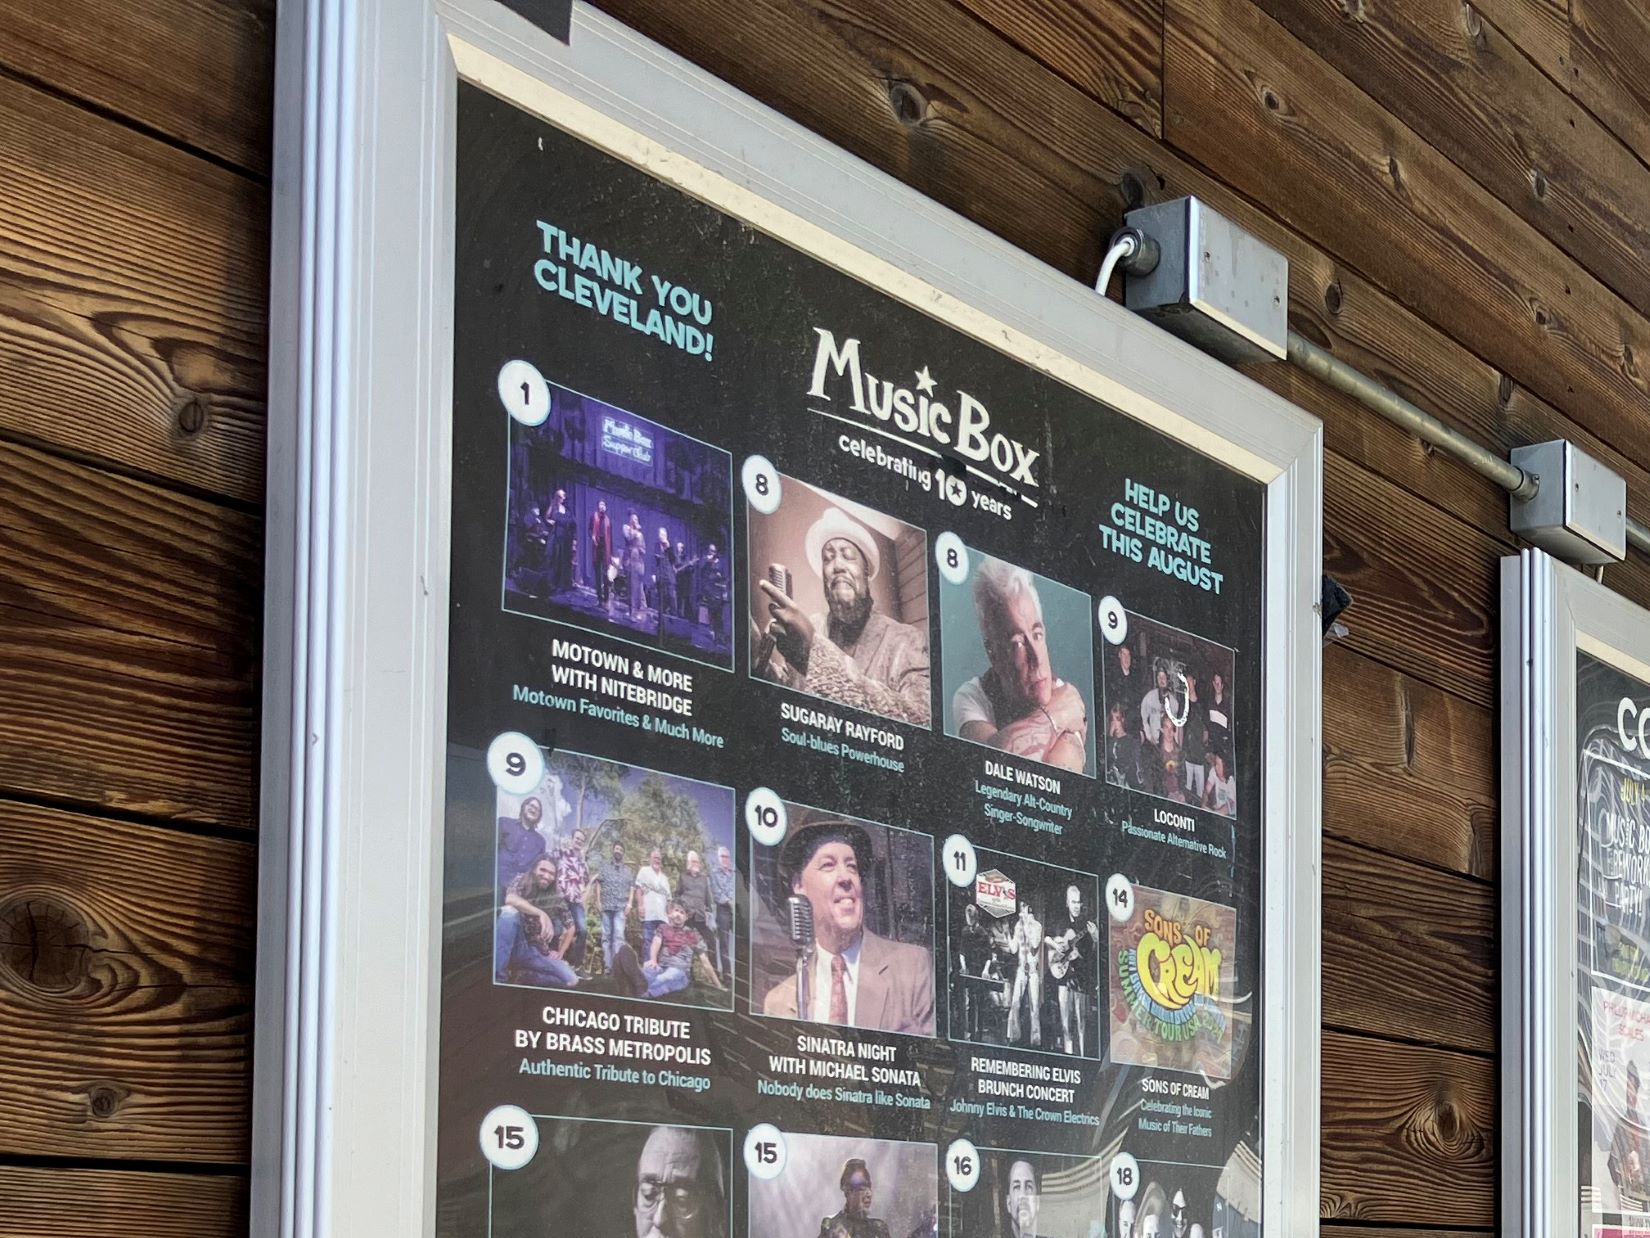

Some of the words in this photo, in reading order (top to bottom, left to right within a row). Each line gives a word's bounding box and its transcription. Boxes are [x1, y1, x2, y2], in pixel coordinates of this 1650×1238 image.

[537, 220, 643, 294] THANK
[651, 275, 712, 325] YOU
[534, 259, 713, 362] CLEVELAND!
[520, 381, 530, 405] 1
[807, 327, 953, 446] Music
[756, 473, 768, 496] 8
[839, 435, 931, 492] celebrating
[935, 468, 967, 507] 10
[971, 488, 1012, 521] years
[1124, 478, 1170, 517] HELP
[1175, 501, 1199, 531] US
[1111, 503, 1212, 565] CELEBRATE
[946, 548, 958, 568] 8
[1099, 524, 1143, 563] THIS
[1148, 547, 1223, 595] AUGUST
[1107, 611, 1119, 630] 9
[552, 639, 630, 675] MOTOWN
[632, 661, 644, 680] &
[647, 665, 693, 693] MORE
[551, 664, 597, 692] WITH
[601, 677, 693, 717] NITEBRIDGE
[512, 684, 577, 712] Motown
[580, 698, 640, 728] Favorites
[642, 715, 652, 730] &
[654, 717, 690, 741] Much
[692, 727, 724, 749] More
[781, 702, 843, 734] SUGARAY
[845, 721, 904, 751] RAYFORD
[505, 752, 526, 776] 9
[781, 728, 839, 755] Soul-blues
[841, 743, 905, 773] Powerhouse
[985, 760, 1014, 781] DALE
[1016, 770, 1061, 795] WATSON
[755, 804, 778, 828] 10
[1154, 809, 1195, 832] LOCONTI
[953, 851, 967, 872] 11
[1112, 888, 1128, 908] 14
[1144, 909, 1182, 946] SONS
[1195, 925, 1211, 946] OF
[543, 1006, 620, 1031] CHICAGO
[624, 1015, 690, 1039] TRIBUTE
[515, 1030, 541, 1048] BY
[546, 1033, 605, 1055] BRASS
[609, 1039, 711, 1066] METROPOLIS
[797, 1035, 854, 1058] SINATRA
[858, 1042, 896, 1062] NIGHT
[769, 1055, 806, 1075] WITH
[810, 1060, 868, 1082] MICHAEL
[872, 1068, 921, 1087] SONATA
[971, 1057, 1050, 1082] REMEMBERING
[1053, 1069, 1081, 1084] ELVIS
[978, 1079, 1024, 1098] BRUNCH
[1027, 1084, 1075, 1104] CONCERT
[1142, 1079, 1168, 1095] SONS
[1170, 1082, 1182, 1096] OF
[1183, 1083, 1209, 1100] CREAM
[494, 1126, 524, 1150] 15
[755, 1142, 777, 1164] 15
[954, 1156, 972, 1176] 16
[1117, 1167, 1132, 1186] 18
